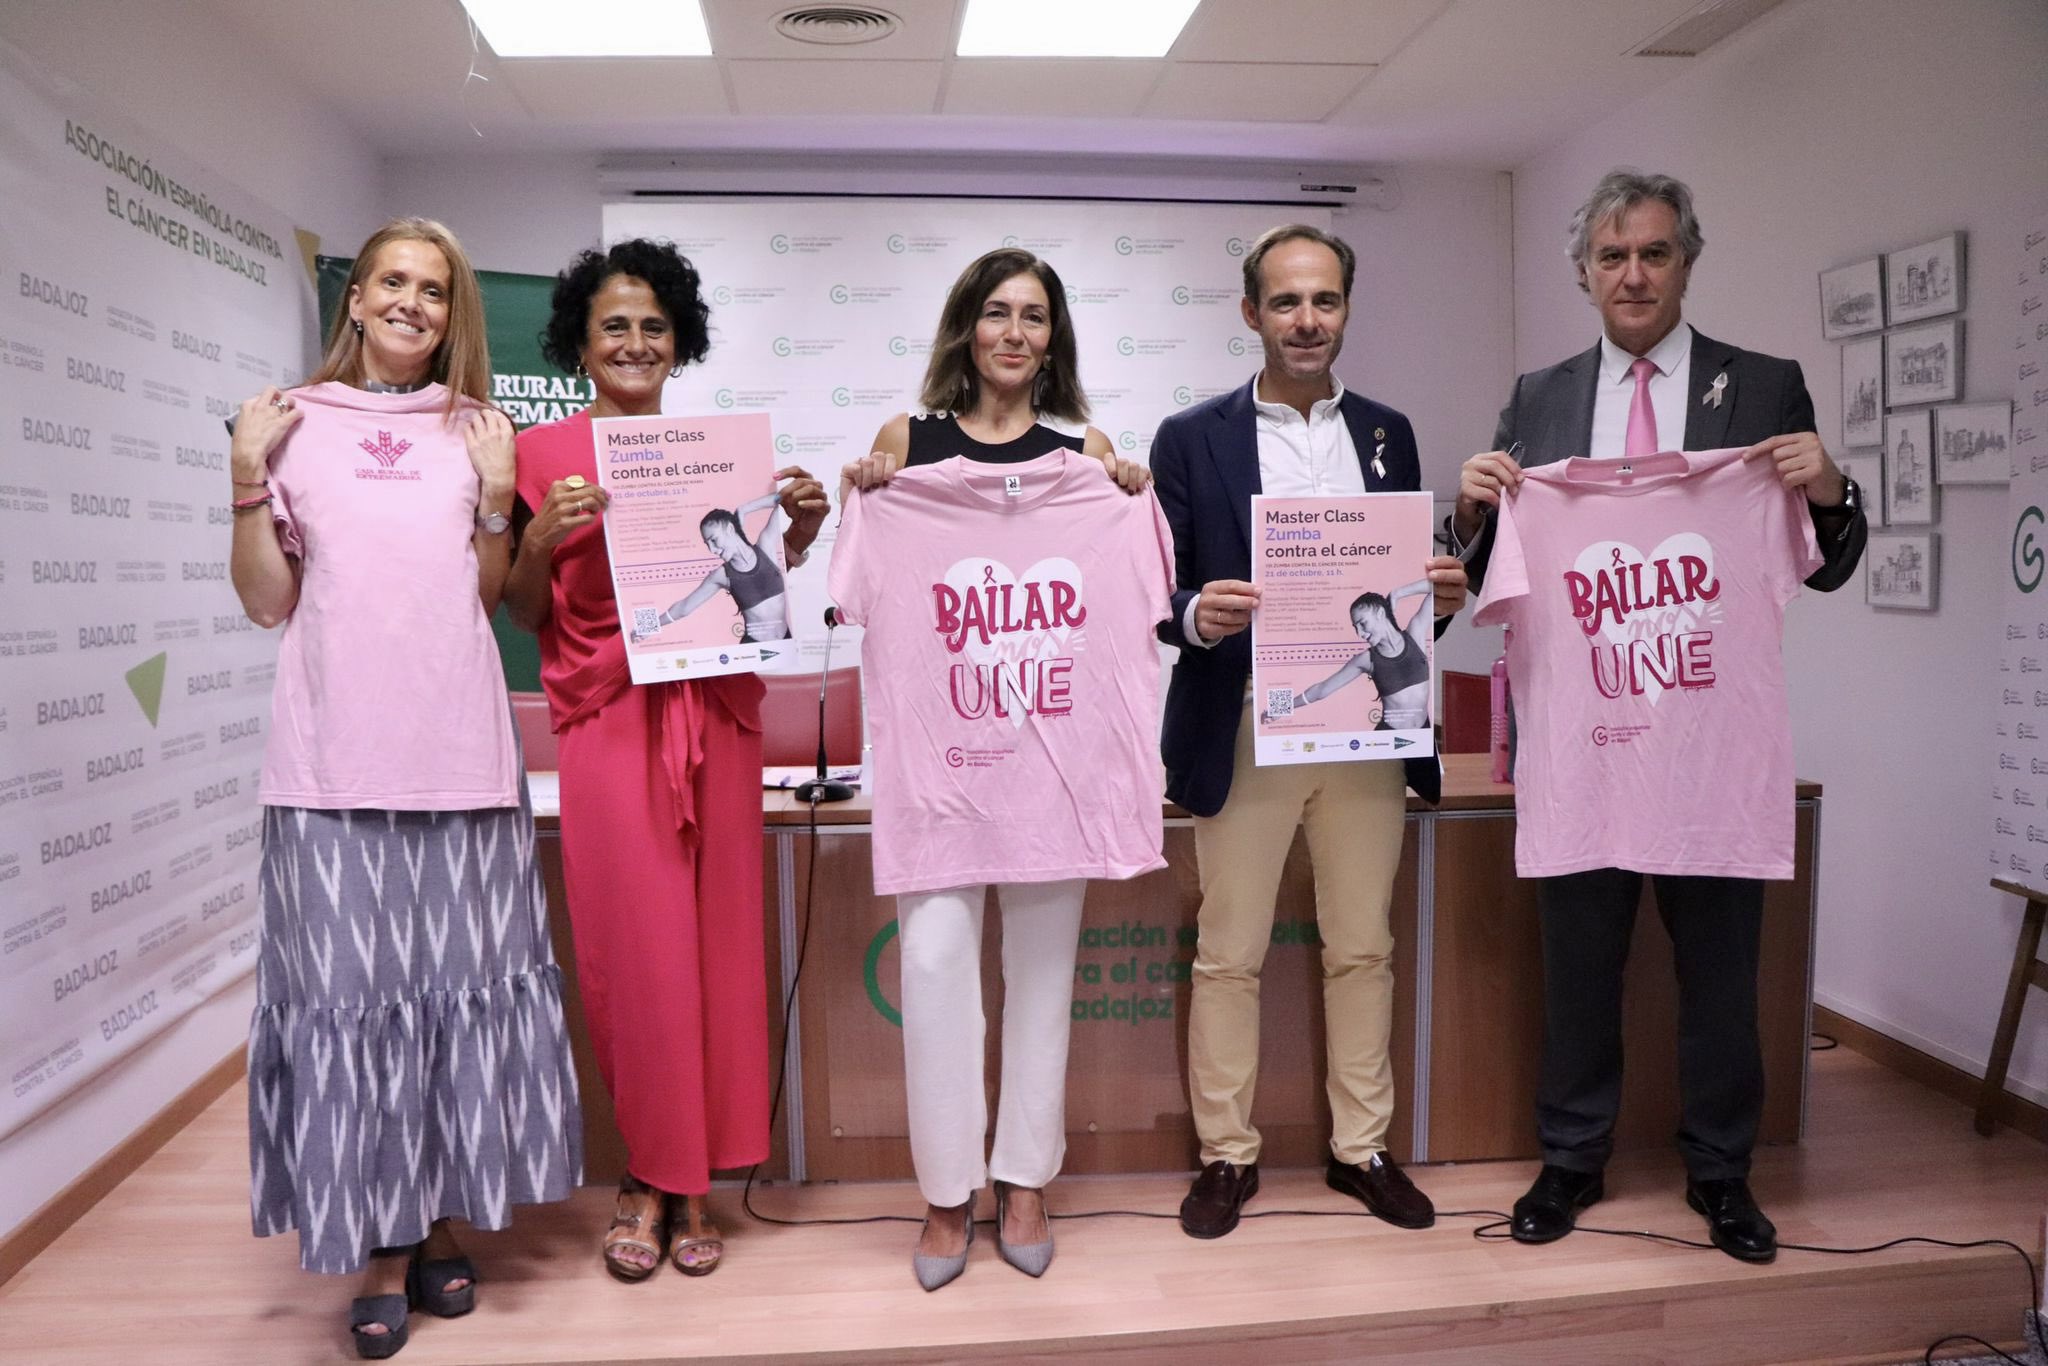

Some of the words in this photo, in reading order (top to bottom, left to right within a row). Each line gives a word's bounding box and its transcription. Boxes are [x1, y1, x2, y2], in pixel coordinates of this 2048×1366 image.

[65, 119, 167, 199] ASOCIACIÓN
[168, 178, 233, 236] ESPAÑOLA
[235, 218, 283, 260] CONTRA
[106, 186, 124, 220] EL
[128, 199, 189, 250] CÁNCER
[193, 231, 211, 260] EN
[214, 236, 267, 286] BADAJOZ
[20, 272, 88, 317] BADAJOZ
[172, 329, 221, 362] BADAJOZ
[67, 356, 126, 392] BADAJOZ
[493, 374, 585, 400] RURAL
[23, 417, 92, 450] BADAJOZ
[608, 432, 661, 447] Master
[664, 429, 705, 443] Class
[176, 446, 223, 471] BADAJOZ
[610, 448, 664, 464] Zumba
[611, 465, 661, 480] contra
[665, 463, 679, 476] el
[685, 460, 734, 475] cáncer
[71, 492, 131, 519] BADAJOZ
[624, 490, 635, 499] de
[1266, 511, 1320, 524] Master
[1324, 509, 1365, 522] Class
[1265, 527, 1321, 541] Zumba
[1265, 544, 1317, 558] contra
[1321, 543, 1335, 557] el
[1340, 542, 1392, 556] cáncer
[33, 560, 97, 583] BADAJOZ
[182, 562, 226, 581] BADAJOZ
[1265, 570, 1274, 578] 21
[1276, 569, 1287, 577] de
[1563, 552, 1721, 637] BAILAR
[932, 570, 1087, 653] BAILAR
[79, 623, 137, 650] BADAJOZ
[1591, 631, 1716, 700] UNE
[187, 670, 232, 695] BADAJOZ
[950, 657, 1074, 720] UNE
[37, 693, 105, 725] BADAJOZ
[219, 716, 261, 744] BADAJOZ
[87, 747, 145, 783] BADAJOZ
[194, 777, 240, 810] BADAJOZ
[40, 822, 112, 865] BADAJOZ
[90, 869, 152, 914] BADAJOZ
[201, 882, 245, 921] BADAJOZ
[53, 948, 118, 1002] BADAJOZ
[1110, 956, 1137, 983] el
[100, 989, 159, 1041] BADAJOZ
[1071, 993, 1174, 1026] adajoz
